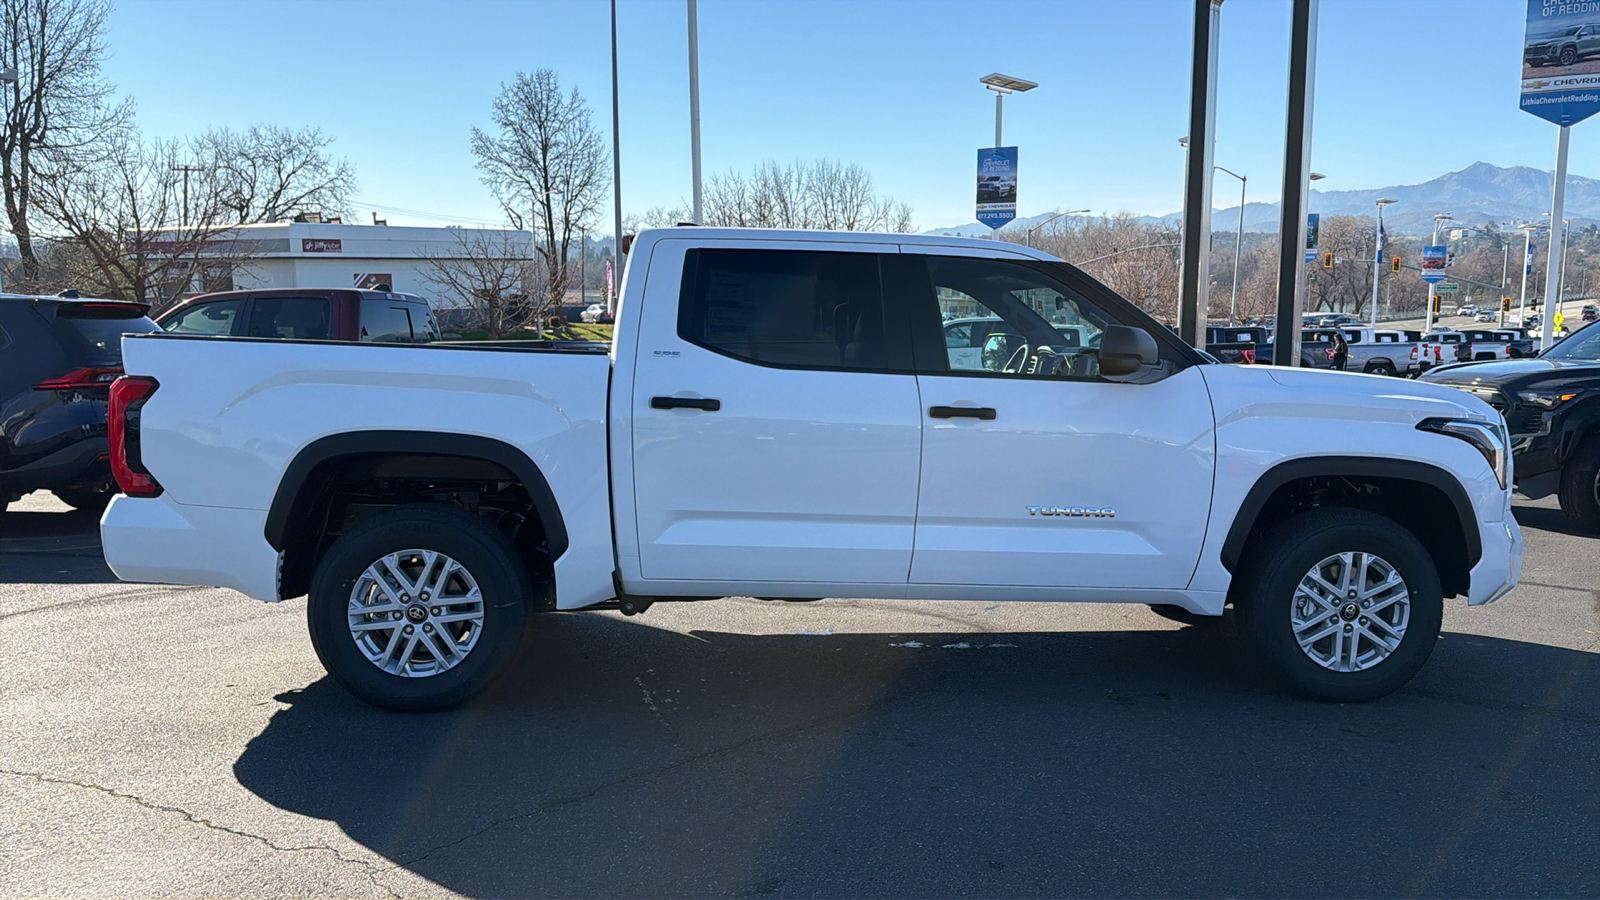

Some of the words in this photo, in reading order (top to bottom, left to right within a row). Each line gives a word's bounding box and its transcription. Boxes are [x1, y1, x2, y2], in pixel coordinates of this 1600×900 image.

[1542, 6, 1556, 17] OF
[1554, 77, 1600, 85] CHEVRO
[1026, 505, 1115, 517] TUNDRA
